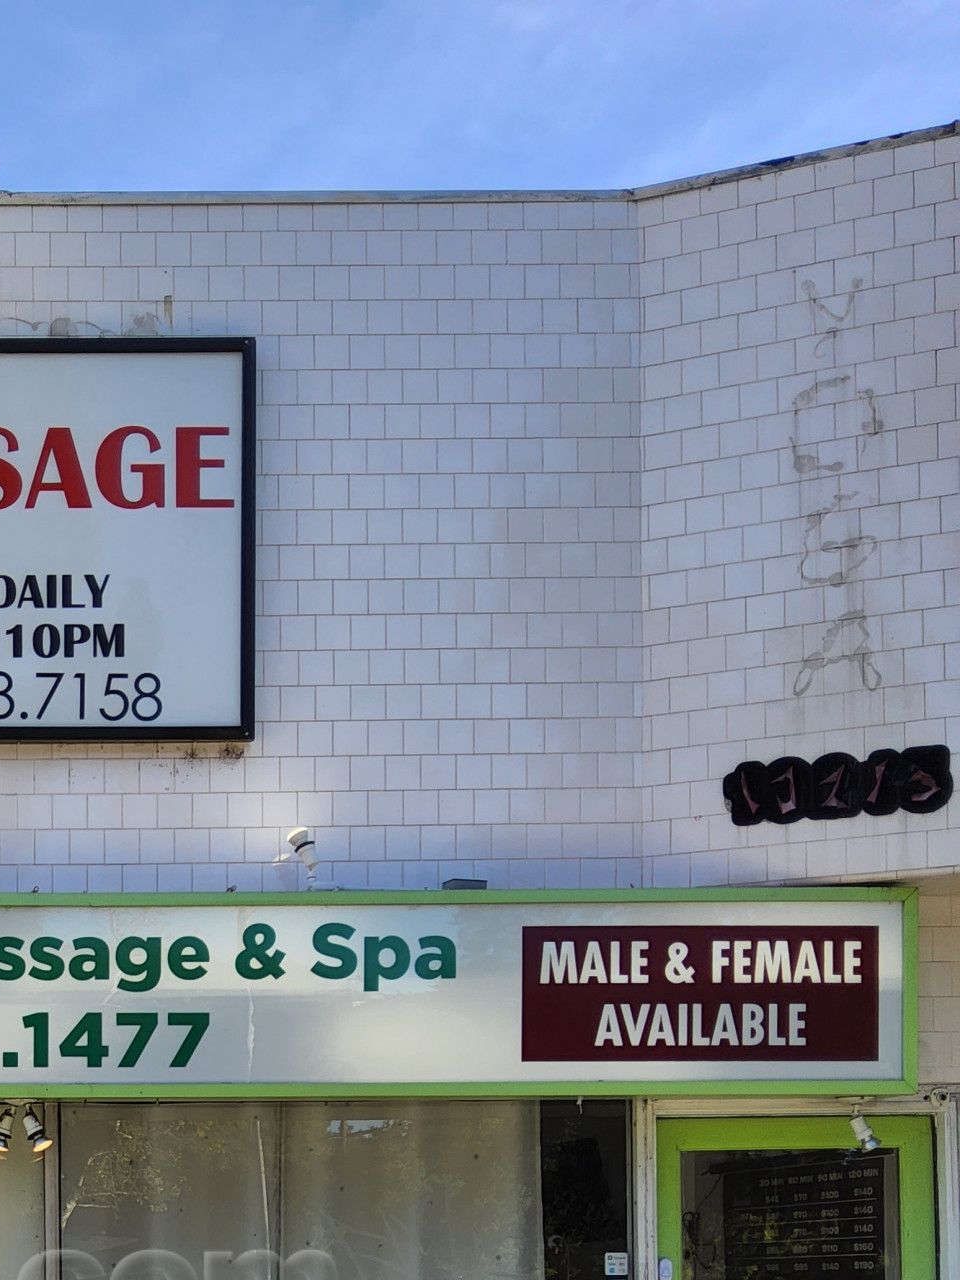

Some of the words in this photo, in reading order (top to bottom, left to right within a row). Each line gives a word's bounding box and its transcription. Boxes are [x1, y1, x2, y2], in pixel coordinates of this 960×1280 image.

[5, 623, 125, 658] 10PM
[234, 922, 286, 981] &
[311, 922, 457, 992] Spa
[540, 940, 649, 985] MALE
[664, 942, 697, 984] &
[710, 940, 862, 985] FEMALE
[594, 1003, 807, 1047] AVAILABLE
[853, 1186, 873, 1196] $140
